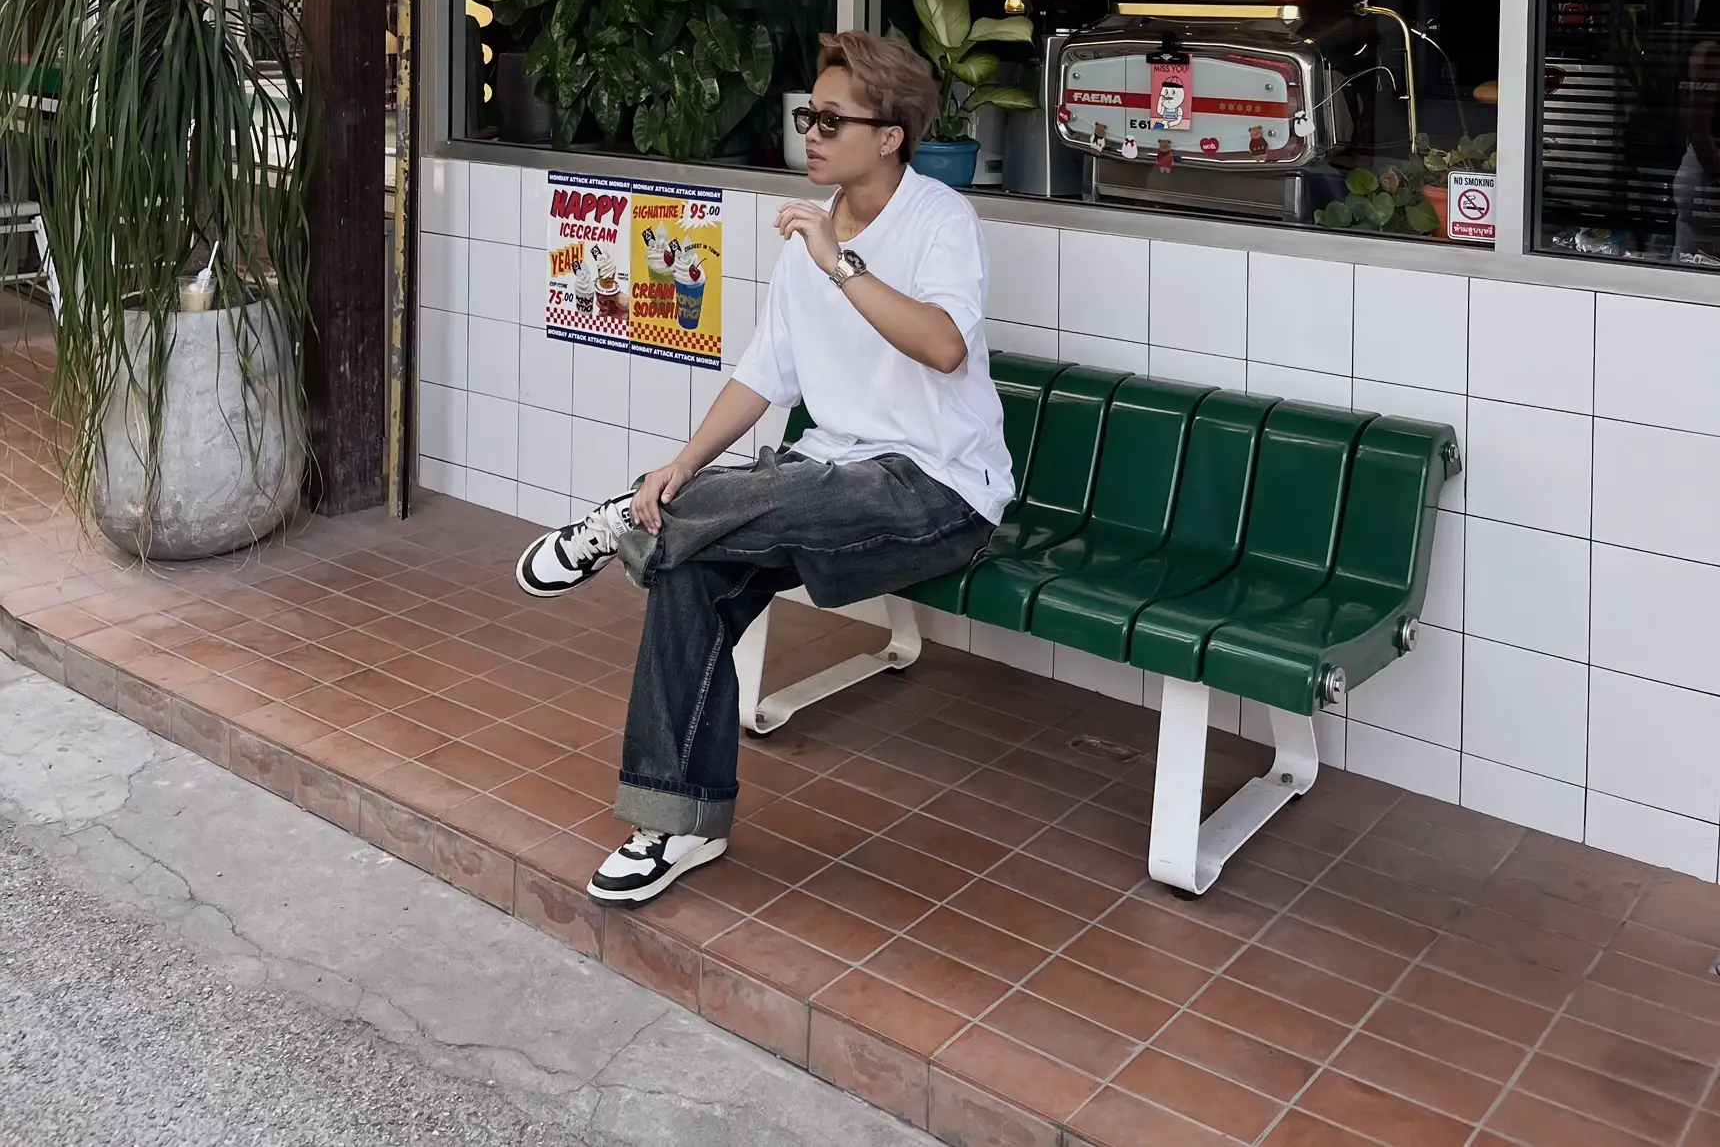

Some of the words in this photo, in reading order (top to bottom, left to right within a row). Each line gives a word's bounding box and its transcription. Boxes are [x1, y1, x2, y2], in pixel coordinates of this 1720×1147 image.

[1073, 92, 1122, 104] FAEMA
[549, 174, 569, 182] MONDAY
[570, 176, 588, 184] ATTACK
[589, 178, 608, 186] ATTACK
[609, 180, 631, 189] MONDAY
[1453, 176, 1463, 185] NO
[1464, 178, 1494, 188] SMOKING
[633, 183, 654, 191] MONDAY
[676, 188, 696, 196] ATTACK
[697, 190, 721, 199] MONDAY
[550, 189, 628, 226] HAPPY
[690, 202, 720, 220] 95.00
[560, 222, 618, 244] ICECREAM
[551, 244, 584, 275] YEAH!
[548, 289, 574, 305] 75.00
[631, 282, 675, 300] CREAM
[548, 329, 567, 337] MONDAY
[568, 333, 587, 341] ATTACK
[588, 336, 606, 344] ATTACK
[607, 340, 629, 349] MONDAY
[631, 345, 653, 354] MONDAY
[653, 348, 674, 357] ATTACK
[674, 353, 695, 361] ATTACK
[696, 356, 720, 366] MONDAY
